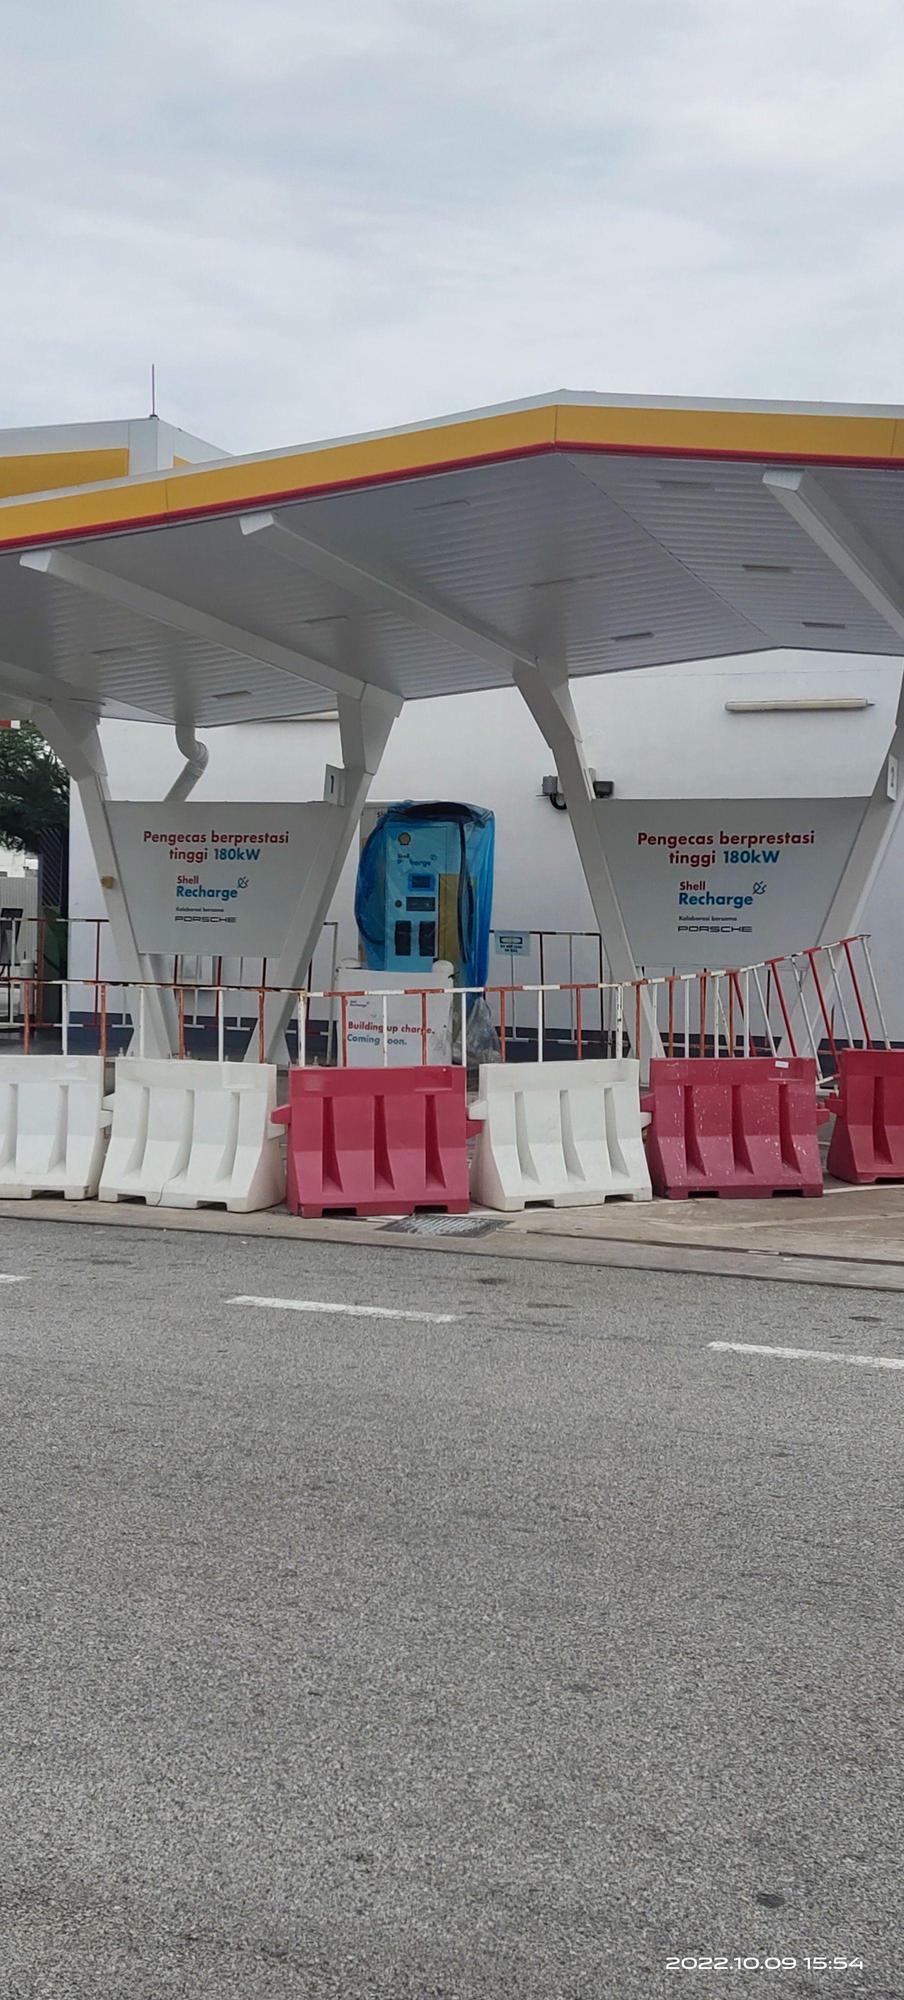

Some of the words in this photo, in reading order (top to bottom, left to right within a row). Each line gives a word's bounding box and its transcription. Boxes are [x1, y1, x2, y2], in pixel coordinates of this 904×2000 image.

[143, 830, 207, 846] Pengecas
[211, 829, 289, 846] berprestasi
[637, 832, 714, 849] Pengecas
[719, 830, 815, 848] berprestasi
[169, 847, 208, 863] tinggi
[214, 848, 261, 861] 180kW
[669, 850, 716, 867] tinggi
[723, 849, 780, 864] 180kW
[176, 875, 199, 885] Shell
[679, 880, 706, 891] Shell
[176, 885, 238, 901] Recharge
[678, 891, 753, 909] Recharge
[174, 915, 237, 923] PORSCHE
[677, 925, 753, 933] PORSCHE
[348, 1021, 384, 1033] Building
[386, 1026, 398, 1035] up
[346, 1033, 380, 1046] Coming
[383, 1037, 408, 1046] oon.
